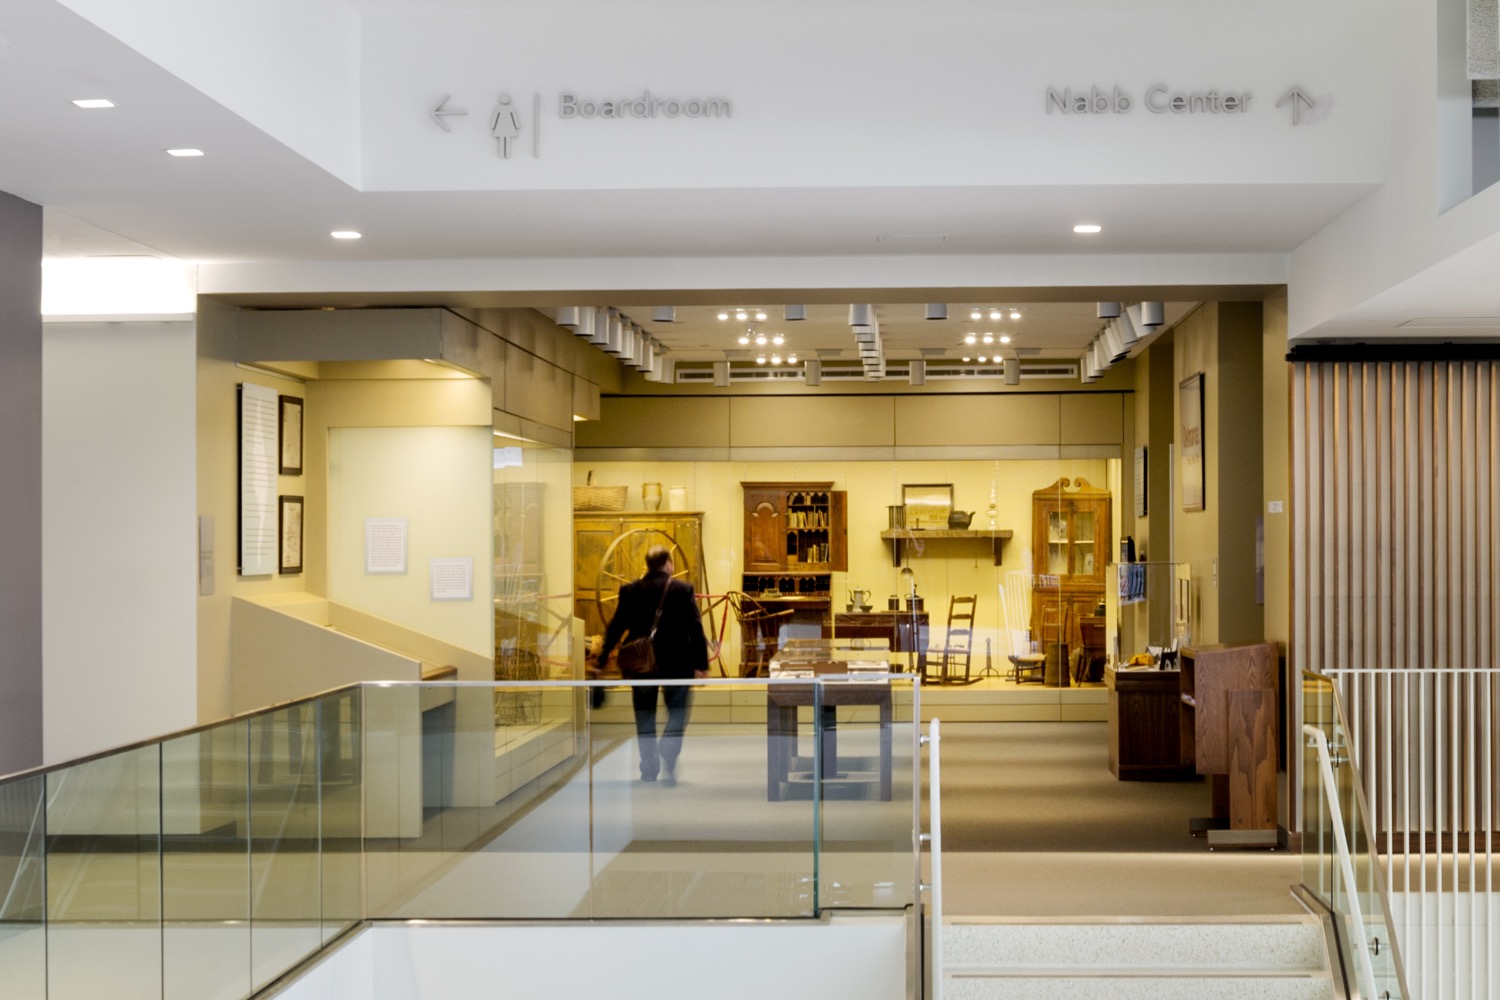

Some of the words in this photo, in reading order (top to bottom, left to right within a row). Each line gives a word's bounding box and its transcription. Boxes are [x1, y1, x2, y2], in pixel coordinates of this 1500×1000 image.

[558, 90, 733, 118] Boardroom
[1046, 85, 1132, 114] Nabb
[1145, 84, 1252, 114] Center
